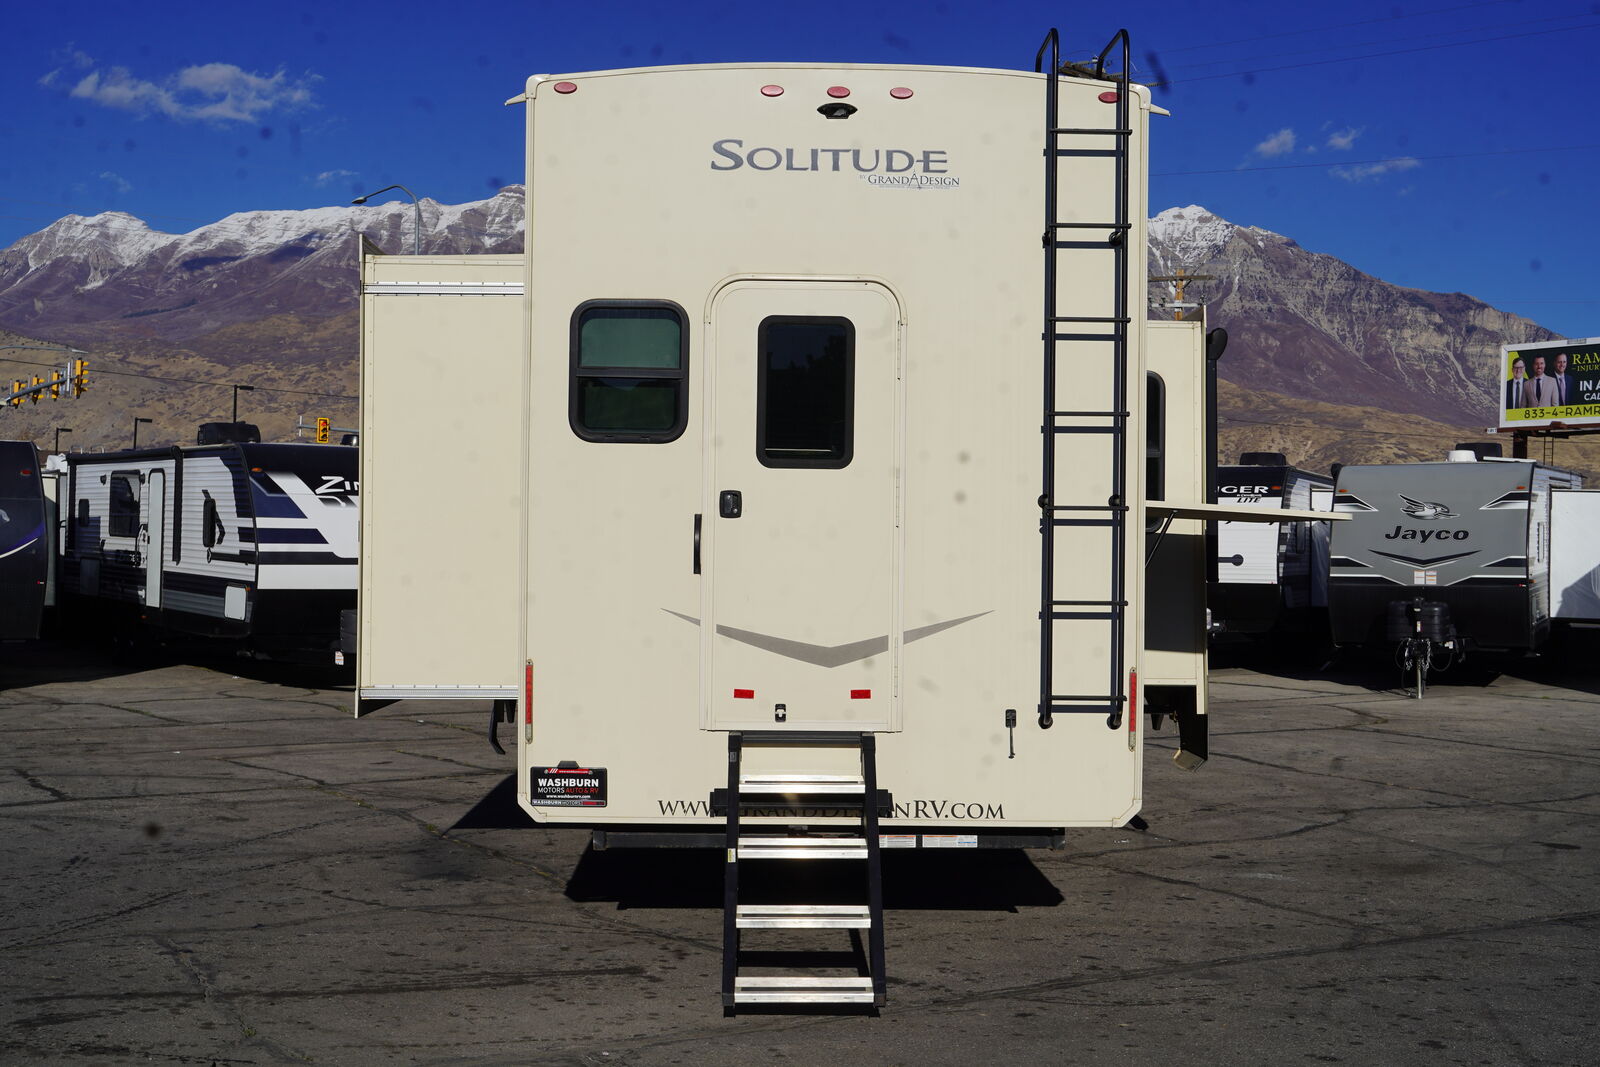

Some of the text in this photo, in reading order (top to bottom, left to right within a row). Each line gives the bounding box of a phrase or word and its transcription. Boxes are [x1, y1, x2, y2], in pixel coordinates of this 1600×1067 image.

[710, 138, 949, 173] SOLITUDE
[1579, 380, 1592, 391] IN
[1217, 485, 1269, 494] GER
[1385, 525, 1470, 543] Jayco
[538, 778, 599, 787] WASHBURN
